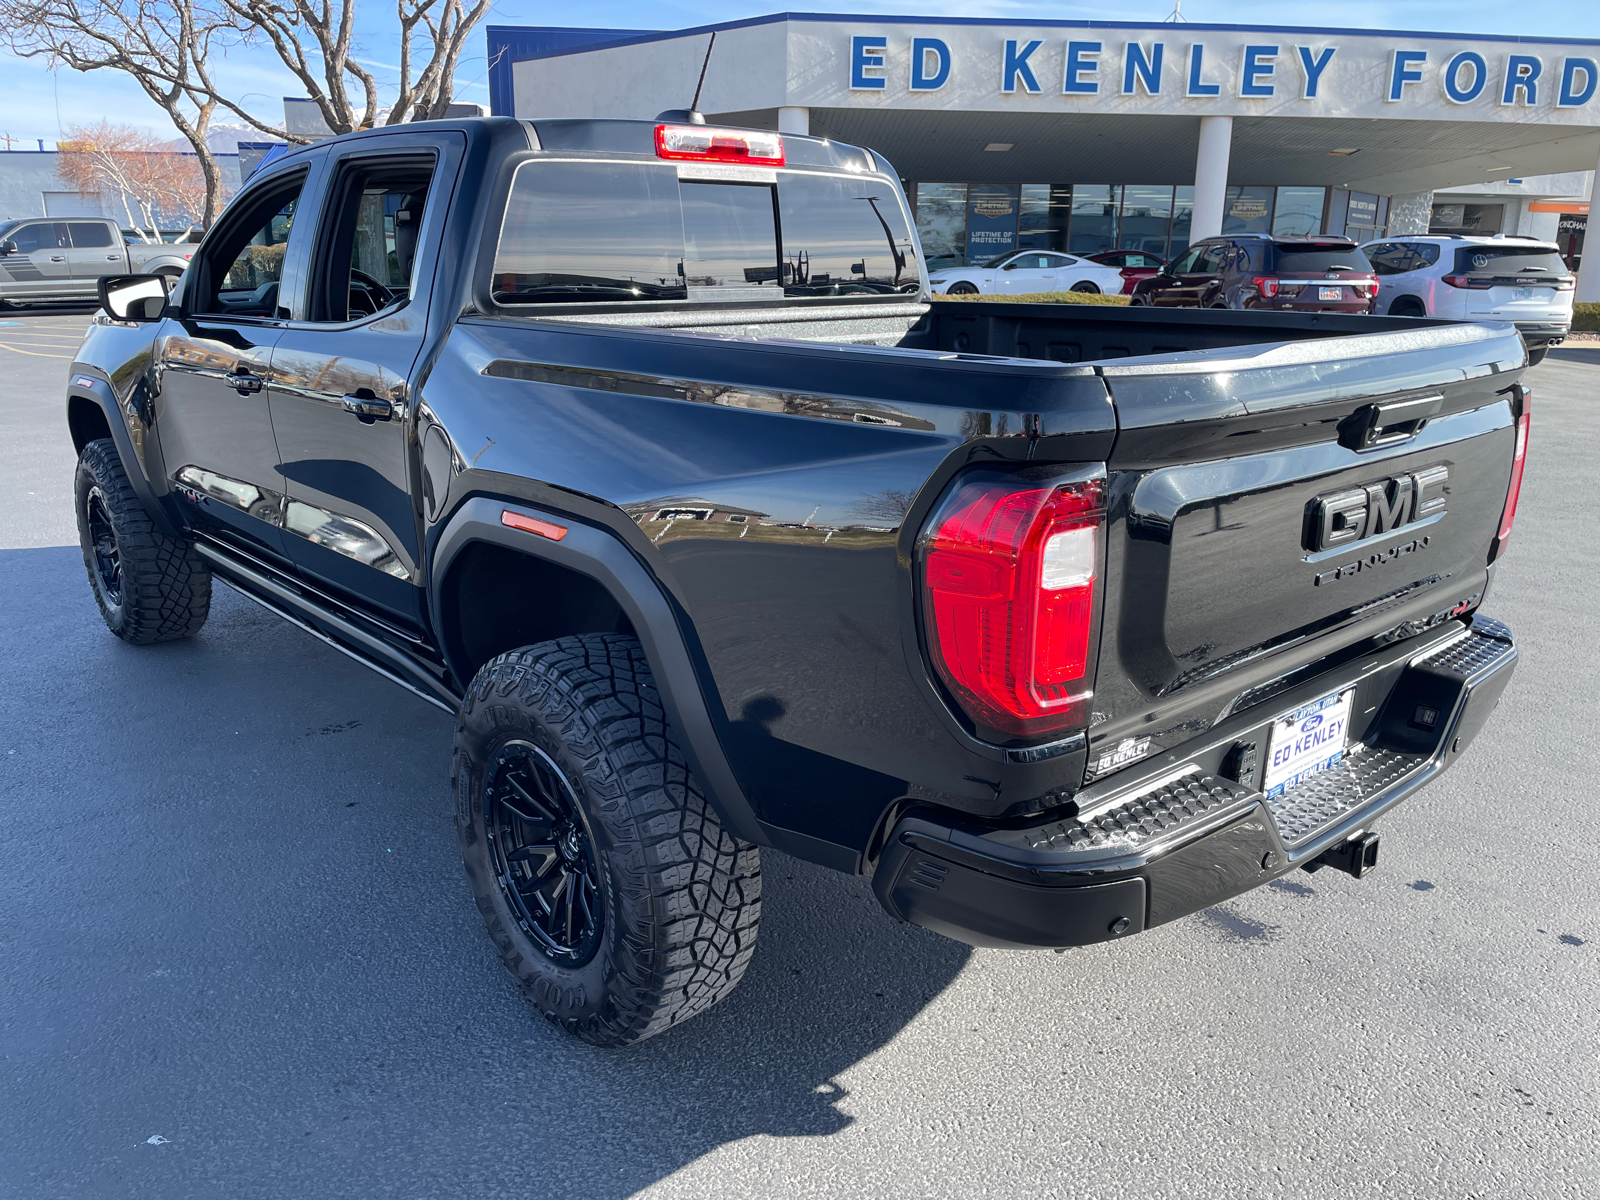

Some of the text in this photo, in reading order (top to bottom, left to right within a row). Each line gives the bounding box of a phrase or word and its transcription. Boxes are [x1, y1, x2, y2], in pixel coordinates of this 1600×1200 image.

[849, 35, 1599, 109] ED KENLEY FORD
[1304, 465, 1449, 552] GMC
[1313, 536, 1431, 587] CANYON
[481, 705, 587, 800] WRANGLER
[1098, 756, 1111, 770] ED
[1112, 741, 1150, 765] KENLEY
[1273, 744, 1291, 768] ED
[1294, 717, 1345, 757] KENLEY
[1284, 777, 1297, 789] ED
[1298, 759, 1329, 783] KENLEY
[479, 893, 587, 1010] GOODYEAR
